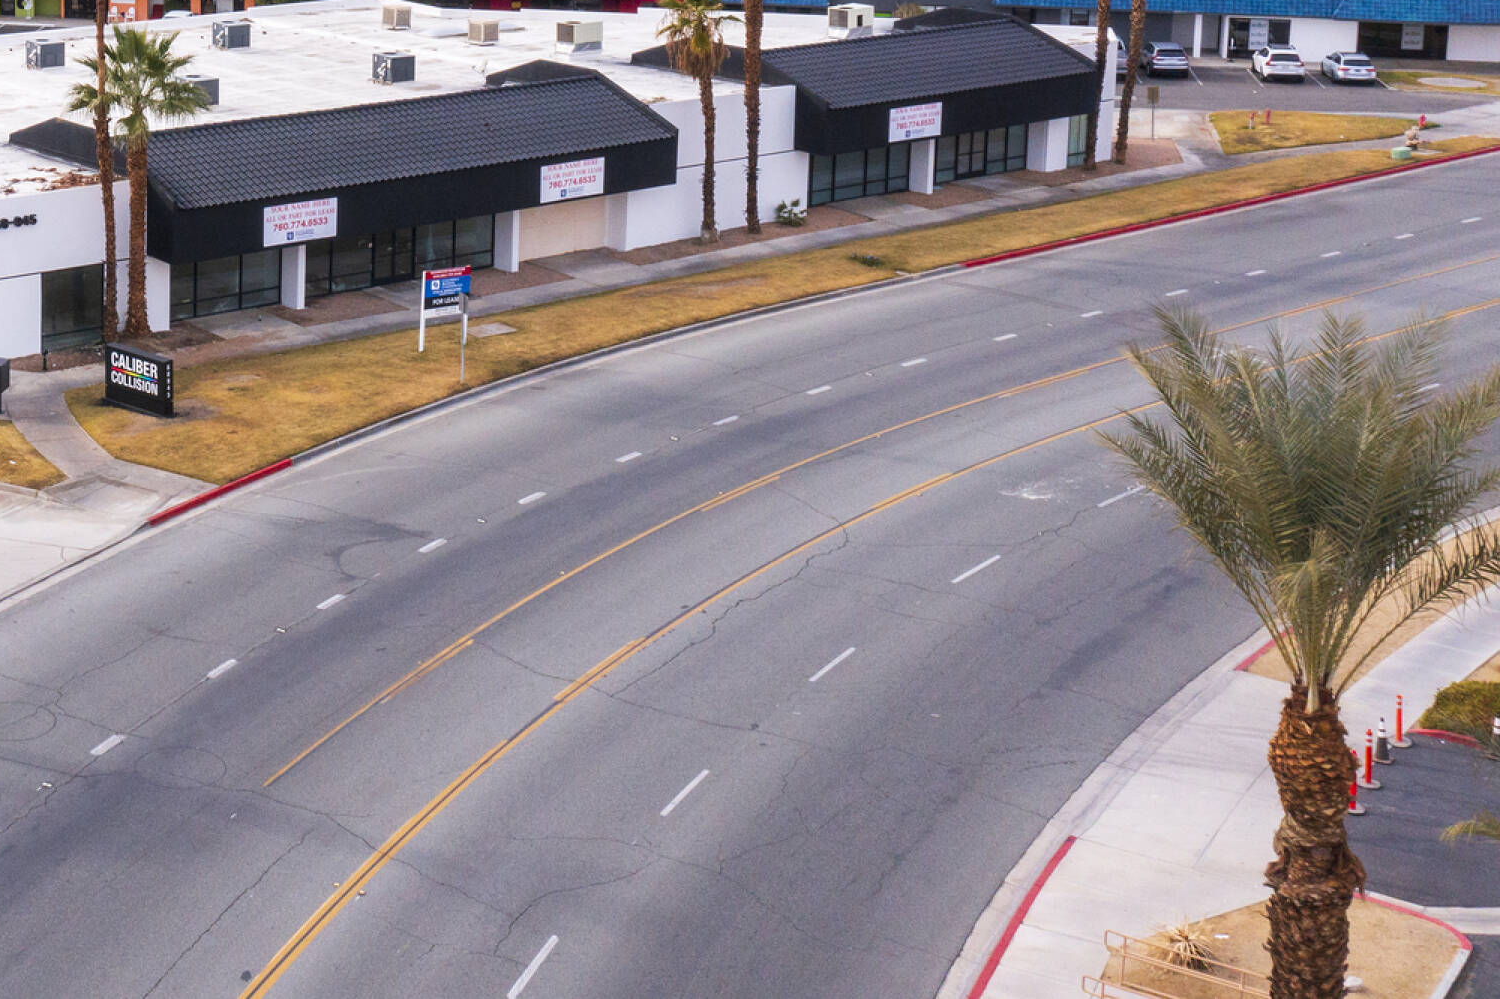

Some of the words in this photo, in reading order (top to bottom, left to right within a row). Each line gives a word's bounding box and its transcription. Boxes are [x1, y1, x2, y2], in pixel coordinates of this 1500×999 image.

[549, 175, 597, 190] 760.774.6533
[273, 216, 328, 232] 760.774.6533
[431, 297, 444, 306] FOR
[110, 351, 158, 379] CALIBER
[110, 370, 158, 397] COLLISION
